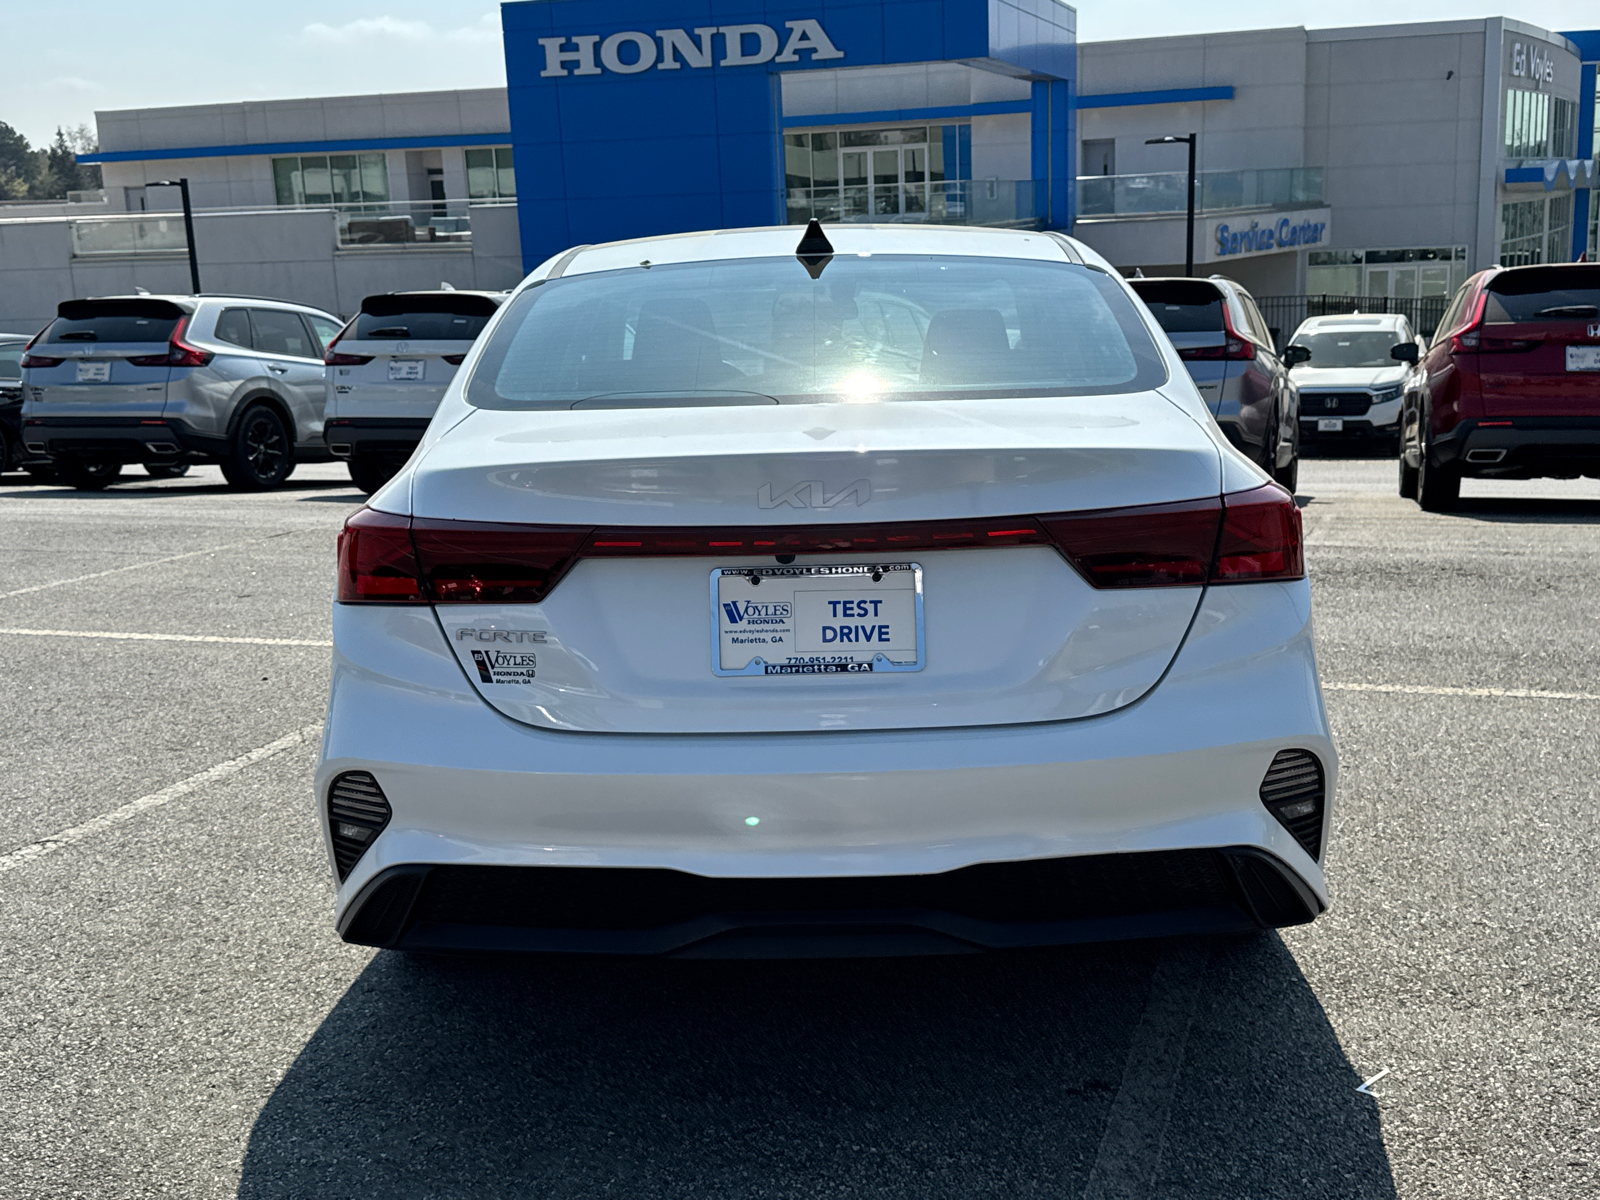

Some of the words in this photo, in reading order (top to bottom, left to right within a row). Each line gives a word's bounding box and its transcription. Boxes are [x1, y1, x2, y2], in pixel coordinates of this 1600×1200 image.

[538, 19, 844, 77] HONDA
[1513, 42, 1527, 77] Ed
[1530, 44, 1554, 89] Voyles
[1217, 221, 1274, 256] Service
[1277, 218, 1326, 248] Center
[757, 479, 871, 509] KIA
[731, 600, 789, 622] VOYLES
[828, 600, 882, 618] TEST
[456, 628, 547, 643] FORTE
[822, 625, 890, 643] DRIVE
[484, 650, 535, 670] VOYLES
[767, 664, 841, 674] Marietta,
[847, 663, 871, 672] GA
